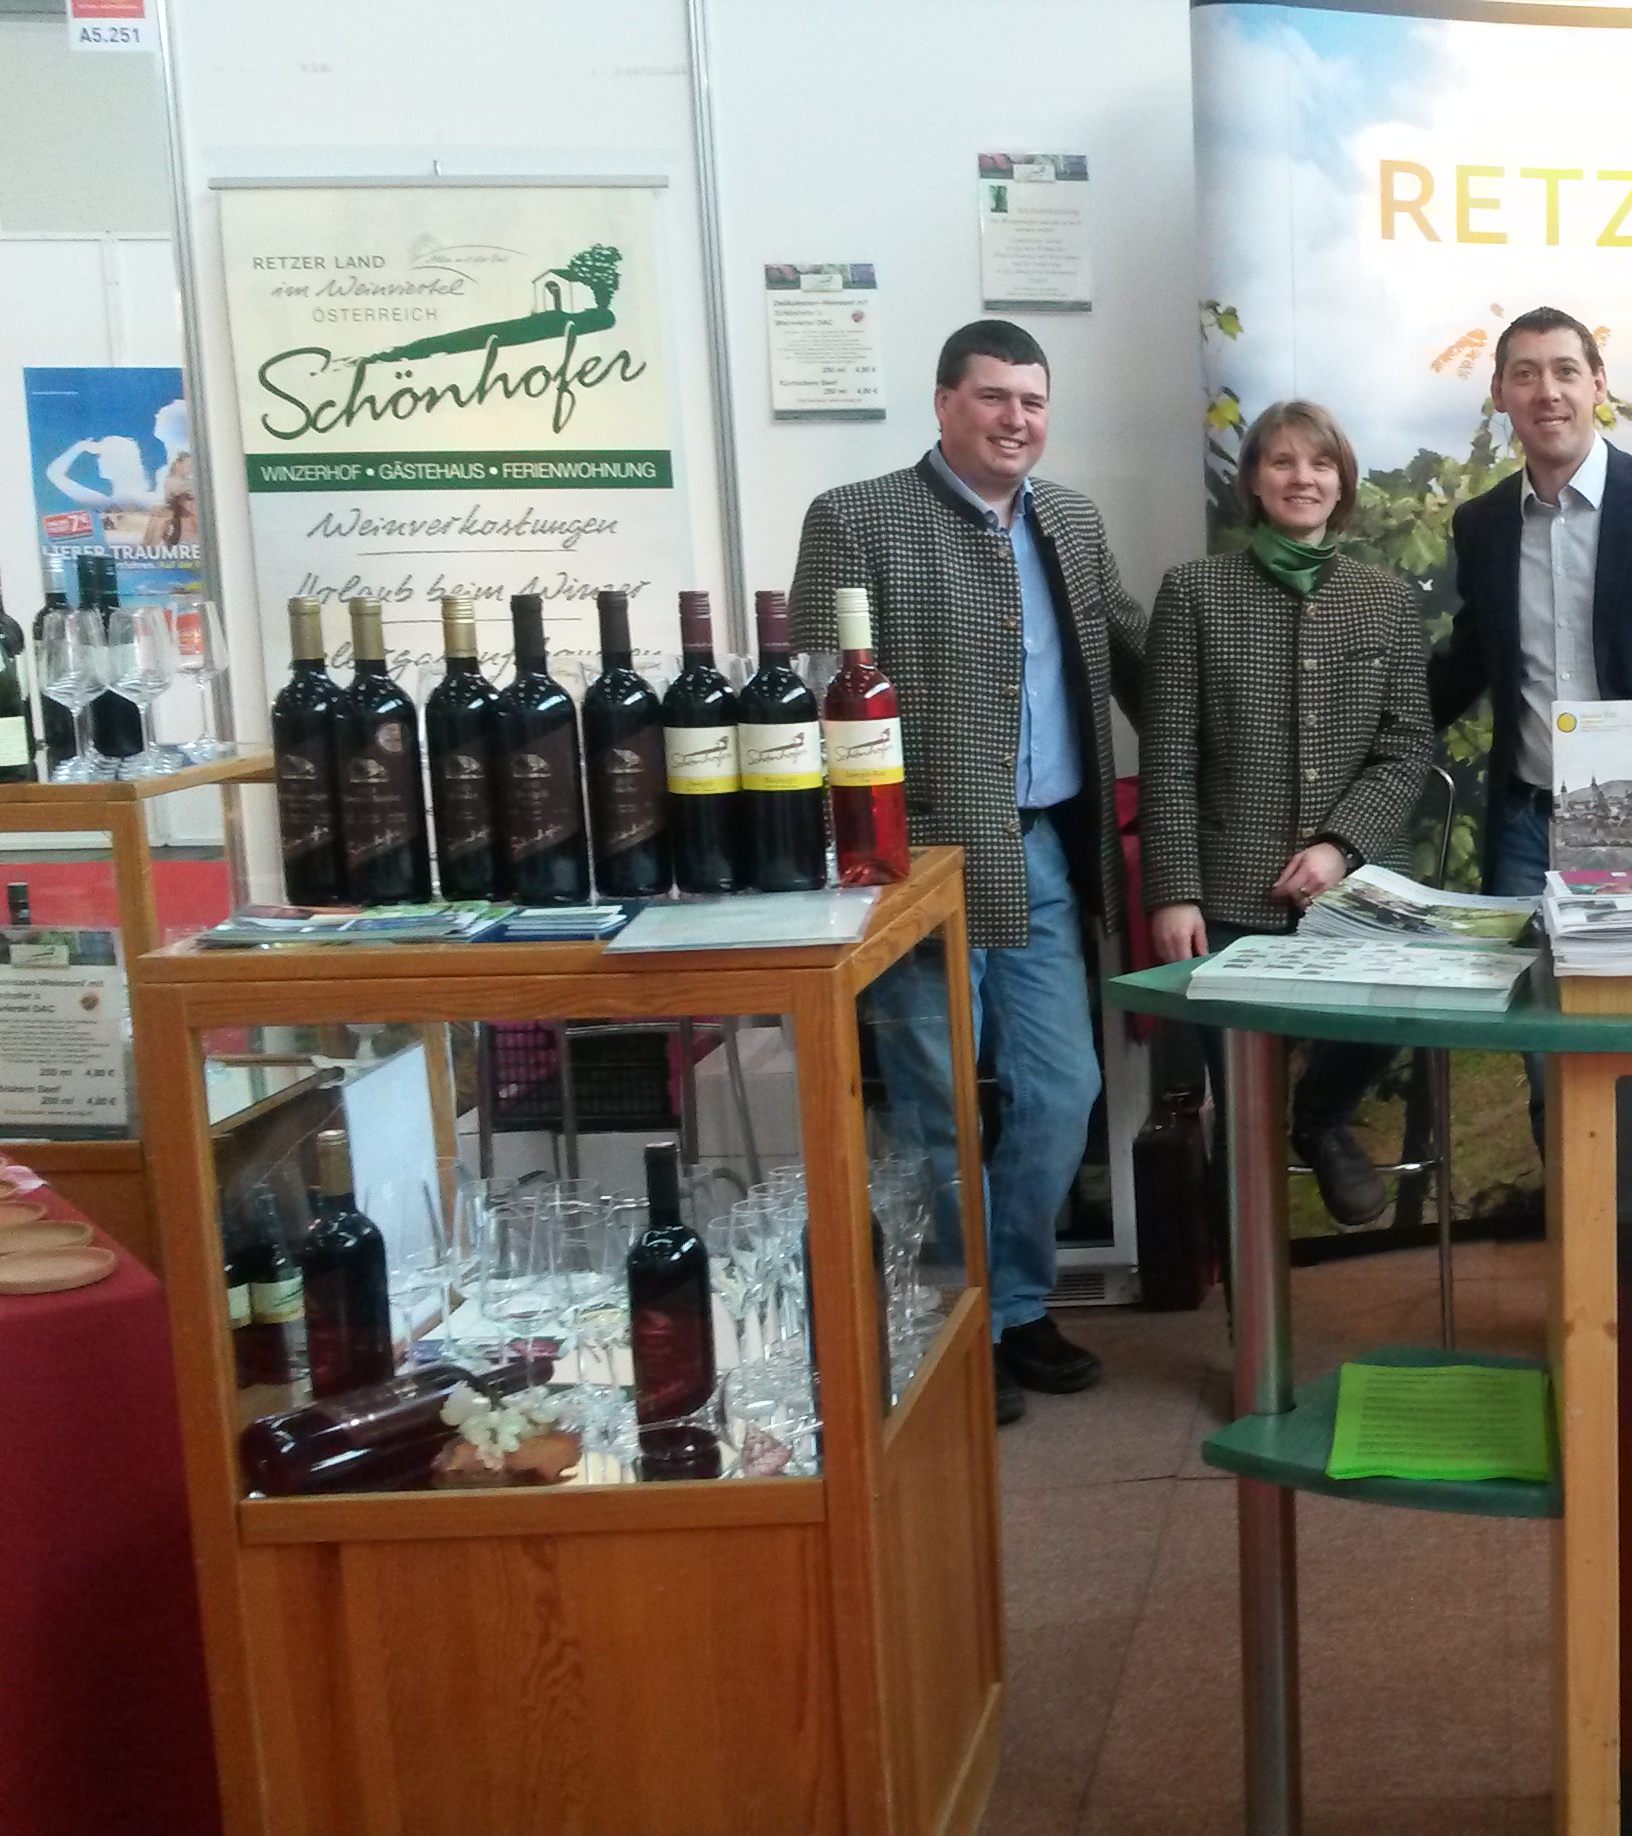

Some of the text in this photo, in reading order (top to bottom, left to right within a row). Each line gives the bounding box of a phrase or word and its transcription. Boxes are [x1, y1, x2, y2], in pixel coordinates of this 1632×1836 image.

[79, 26, 141, 43] A5.251
[252, 254, 387, 270] RETZER LAND
[271, 276, 466, 297] im Weinviertel
[312, 305, 439, 323] ÖSTERREICH
[257, 320, 647, 441] Schönhofer
[260, 460, 657, 482] WINZERHOF GÄSTEHAUS FERIENWOHNUNG
[306, 503, 619, 548] Weinverkostungen
